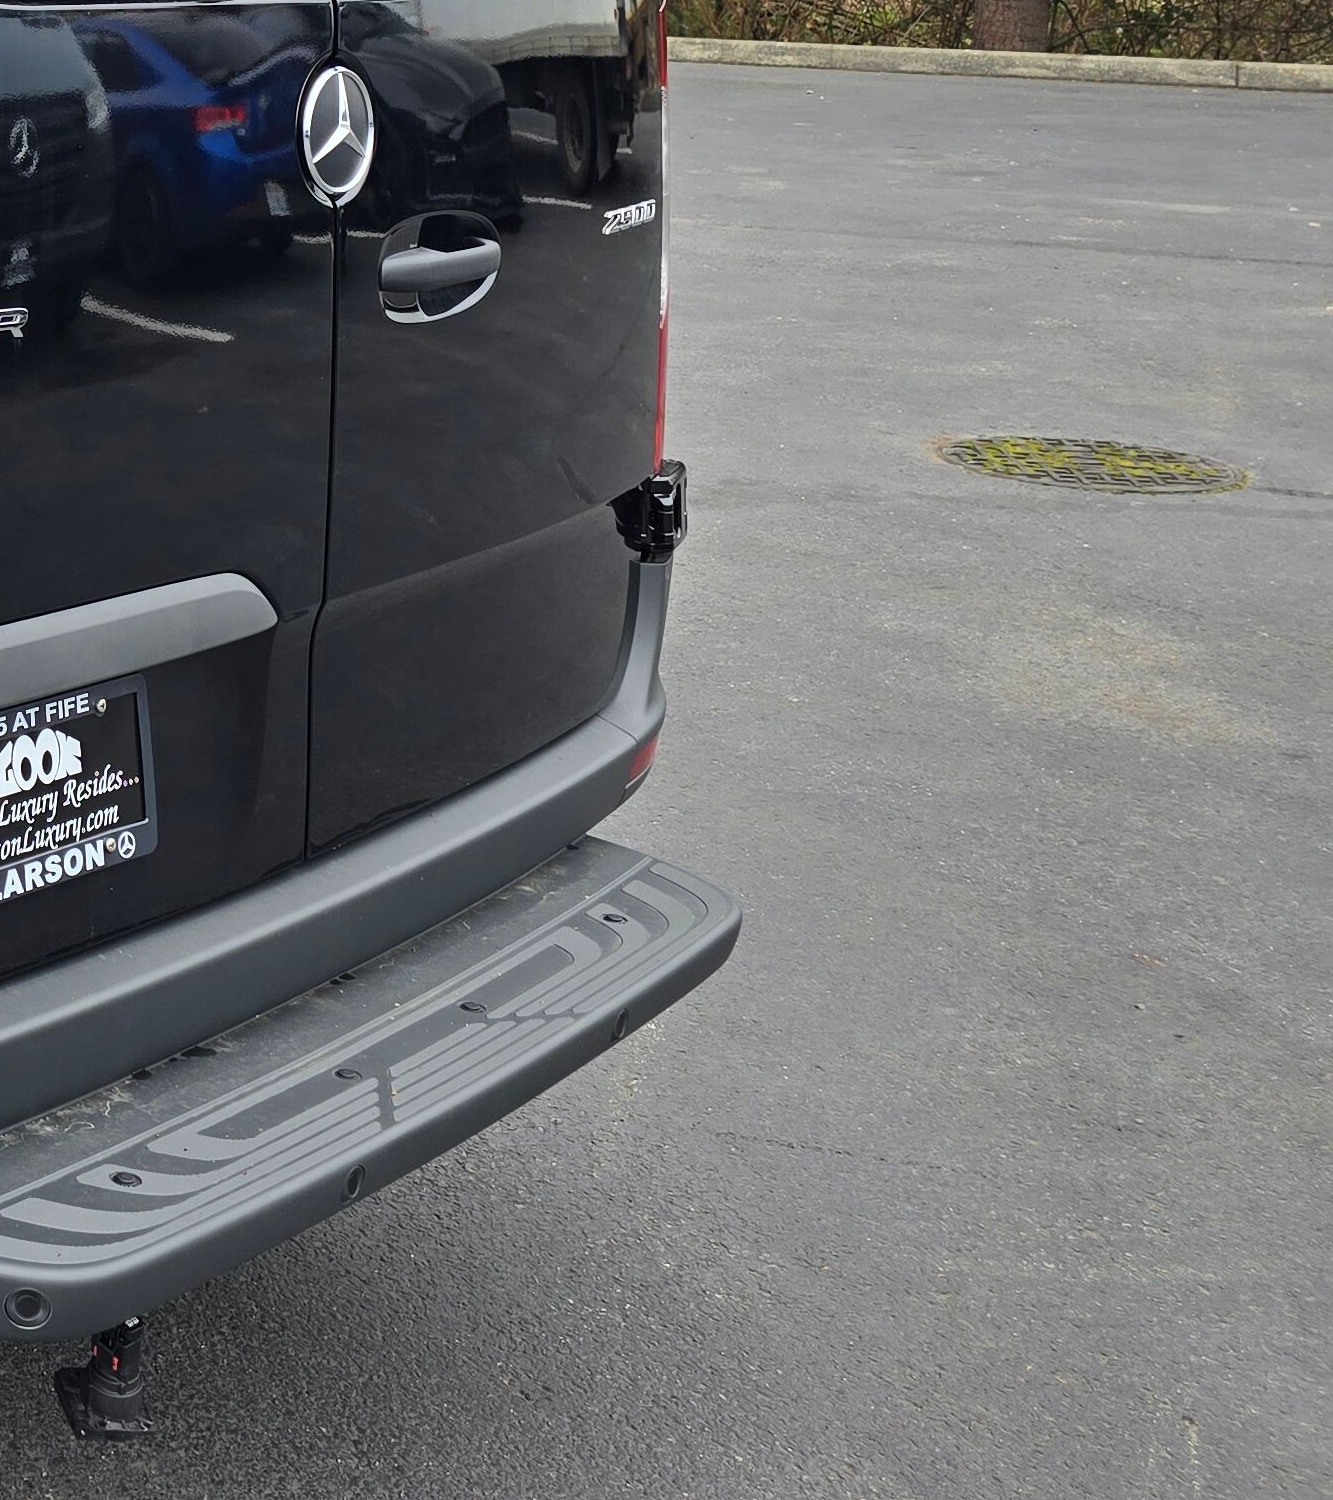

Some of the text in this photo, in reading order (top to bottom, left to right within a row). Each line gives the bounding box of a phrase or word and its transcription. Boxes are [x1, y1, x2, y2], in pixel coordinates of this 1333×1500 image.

[602, 199, 656, 235] 2500
[12, 706, 39, 733] AT
[45, 693, 90, 723] FIFE
[63, 763, 140, 808] Resides...
